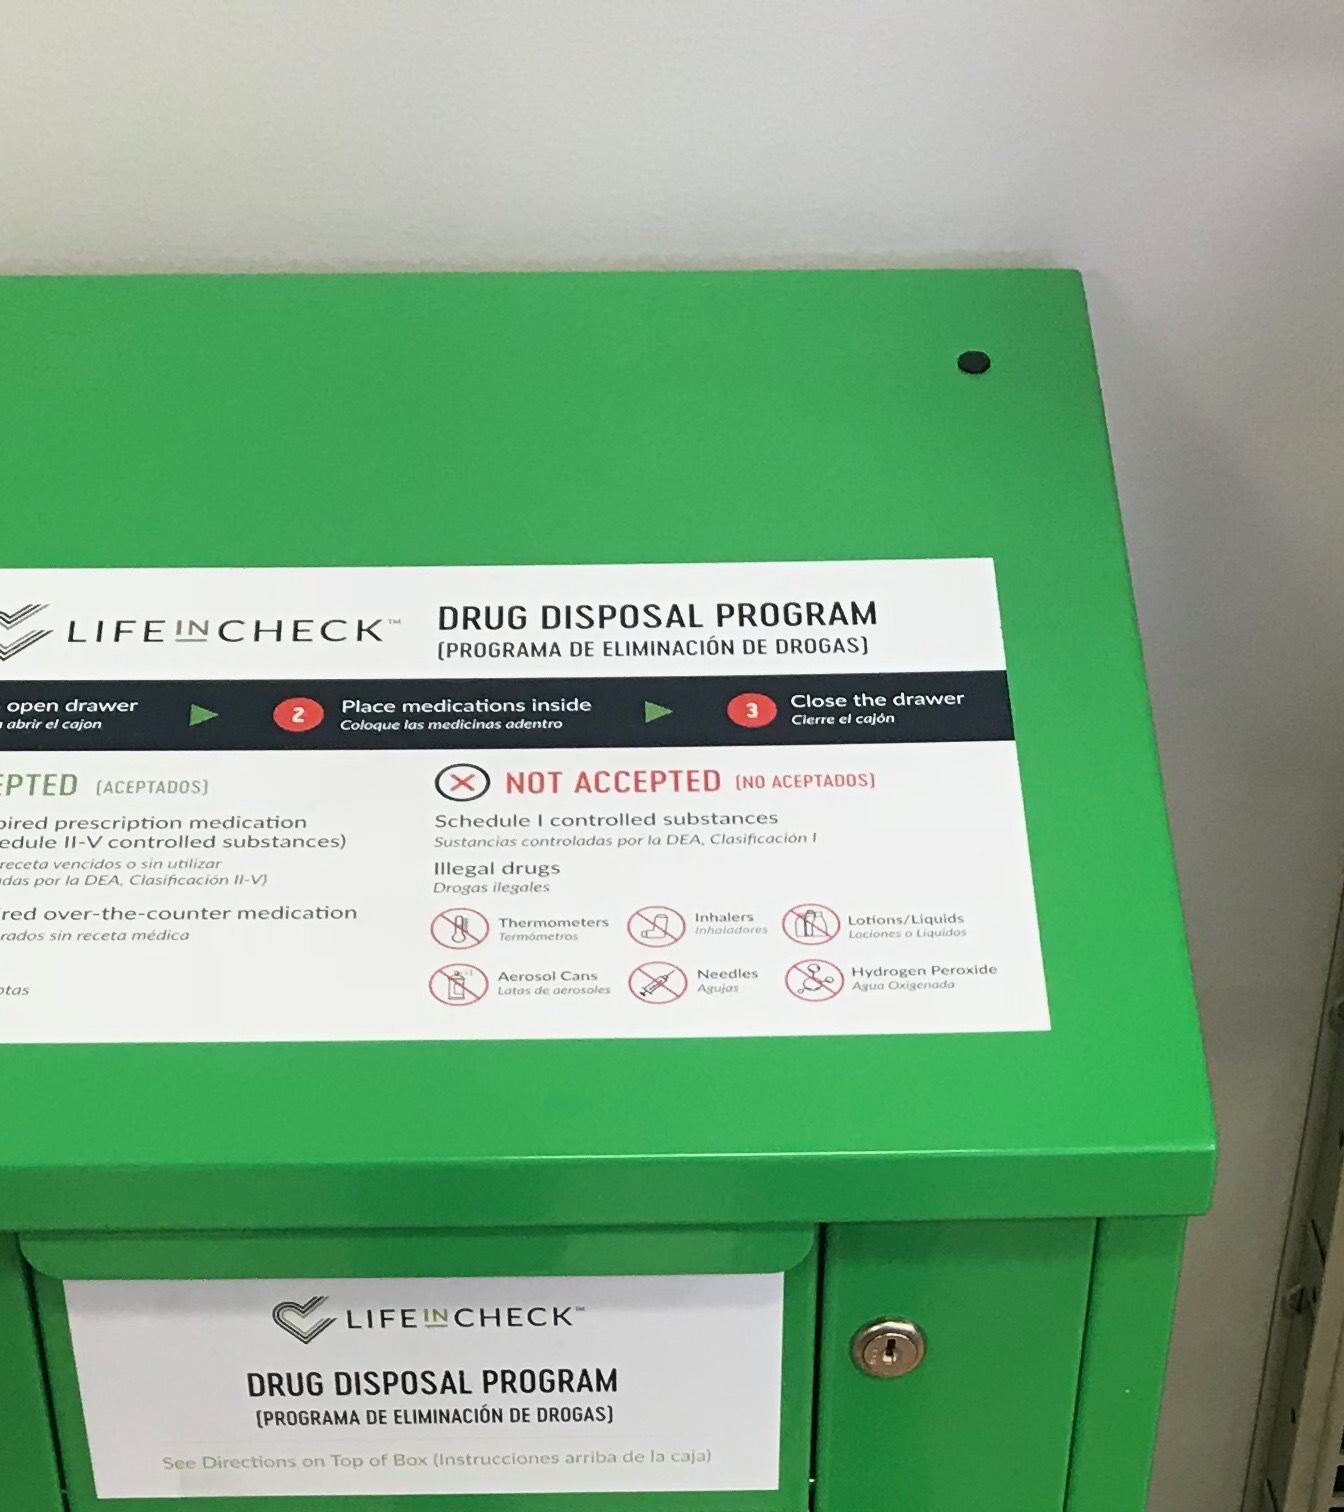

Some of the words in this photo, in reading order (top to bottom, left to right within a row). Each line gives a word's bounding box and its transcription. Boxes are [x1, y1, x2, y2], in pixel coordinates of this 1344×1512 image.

[438, 604, 527, 631] DRUG
[541, 603, 704, 630] DISPOSAL
[716, 600, 877, 628] PROGRAM
[569, 641, 595, 658] DE
[603, 635, 735, 657] ELIMINACIÓN
[742, 638, 768, 655] DE
[6, 701, 59, 715] open
[64, 698, 139, 713] drawer
[341, 699, 396, 714] Place
[402, 698, 526, 713] medications
[531, 697, 593, 712] inside
[790, 693, 848, 709] Close
[852, 692, 887, 708] the
[892, 691, 965, 707] drawer
[291, 706, 305, 723] 2
[746, 702, 759, 719] 3
[506, 770, 563, 795] NOT
[573, 769, 721, 794] ACCEPTED
[54, 815, 182, 833] prescription
[189, 815, 307, 830] medication
[434, 813, 531, 829] Schedule
[538, 813, 543, 828] I
[549, 812, 656, 827] controlled
[663, 811, 779, 826] substances
[434, 861, 495, 879] Illegal
[501, 860, 561, 878] drugs
[498, 917, 610, 929] Thermometers
[695, 912, 755, 923] Inhalers
[847, 913, 965, 926] Lotions/Liquids
[497, 970, 556, 983] Aerosol
[560, 970, 598, 982] Cans
[697, 968, 759, 980] Needles
[851, 965, 927, 979] Hydrogen
[930, 963, 998, 976] Peroxide
[246, 1371, 324, 1398] DRUG
[334, 1369, 473, 1396] DISPOSAL
[482, 1367, 618, 1394] PROGRAM
